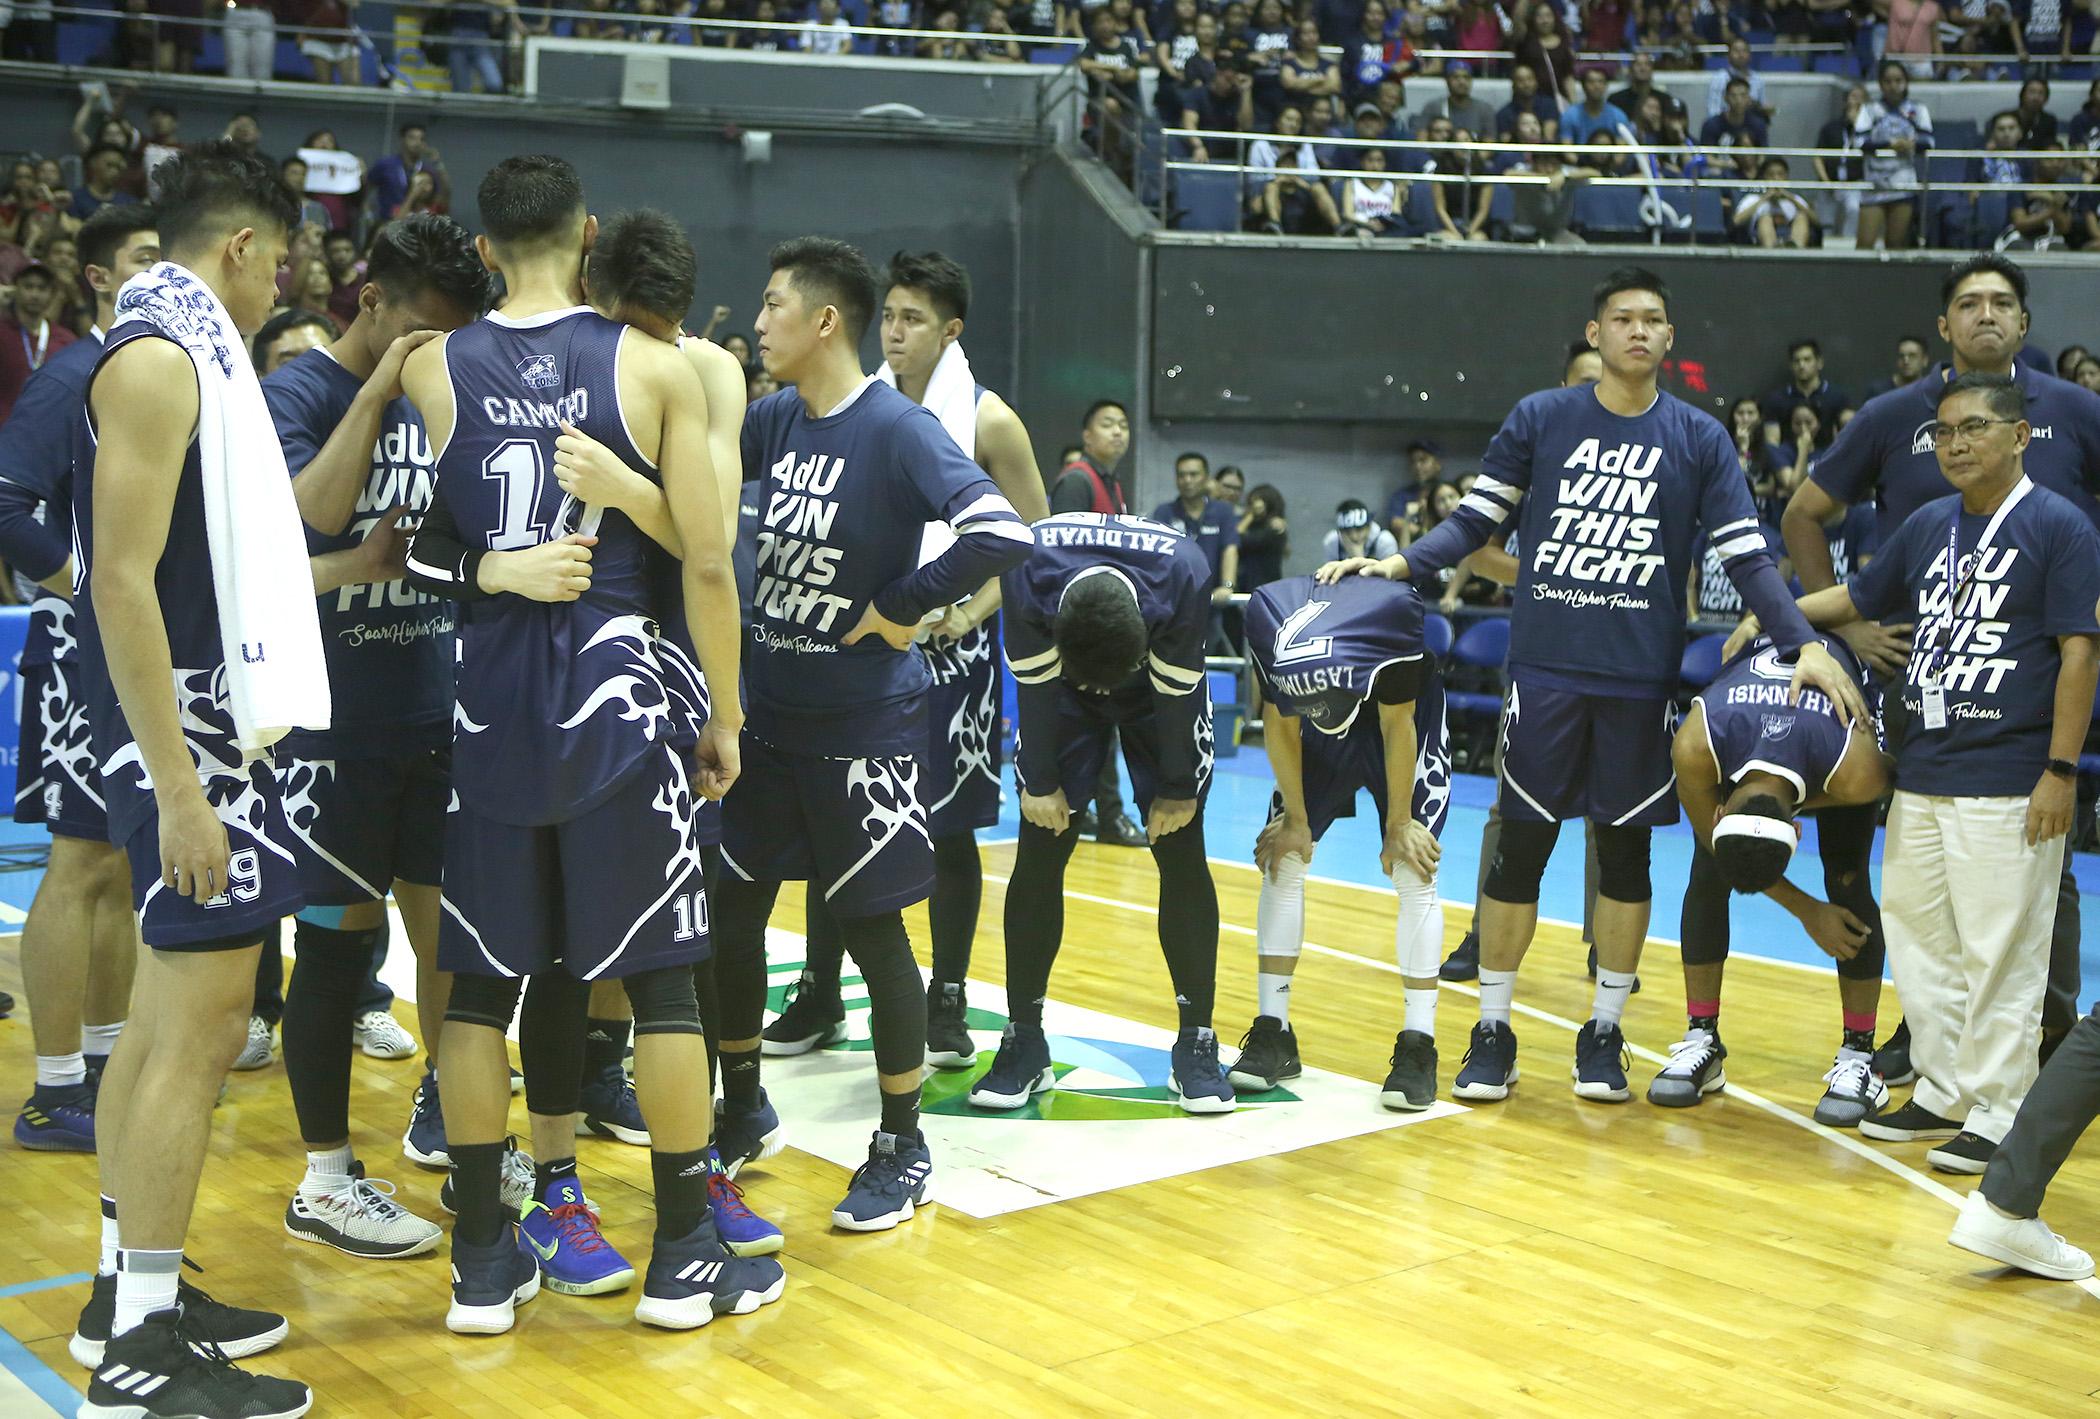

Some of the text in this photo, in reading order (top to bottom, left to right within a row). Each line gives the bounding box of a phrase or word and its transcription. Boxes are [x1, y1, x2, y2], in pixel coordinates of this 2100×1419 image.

[771, 451, 846, 496] AdU
[1563, 437, 1663, 479] AdU
[1557, 472, 1659, 514] WIN
[1039, 527, 1177, 556] ZALDIVAR
[1550, 507, 1660, 552] THIS
[756, 532, 844, 586] THIS
[1533, 540, 1666, 587] FIGHT
[337, 578, 453, 612] FIG
[754, 575, 853, 633] IGHT
[1702, 592, 1744, 611] IGHT
[1918, 581, 2012, 619] WIN
[338, 623, 388, 647] Soar
[1273, 599, 1335, 667] 7
[1269, 666, 1355, 696] LASTIM
[1727, 684, 1834, 717] AHNMISI
[44, 782, 63, 820] 4
[204, 847, 262, 909] 9
[673, 888, 710, 942] 10
[561, 1186, 576, 1203] S
